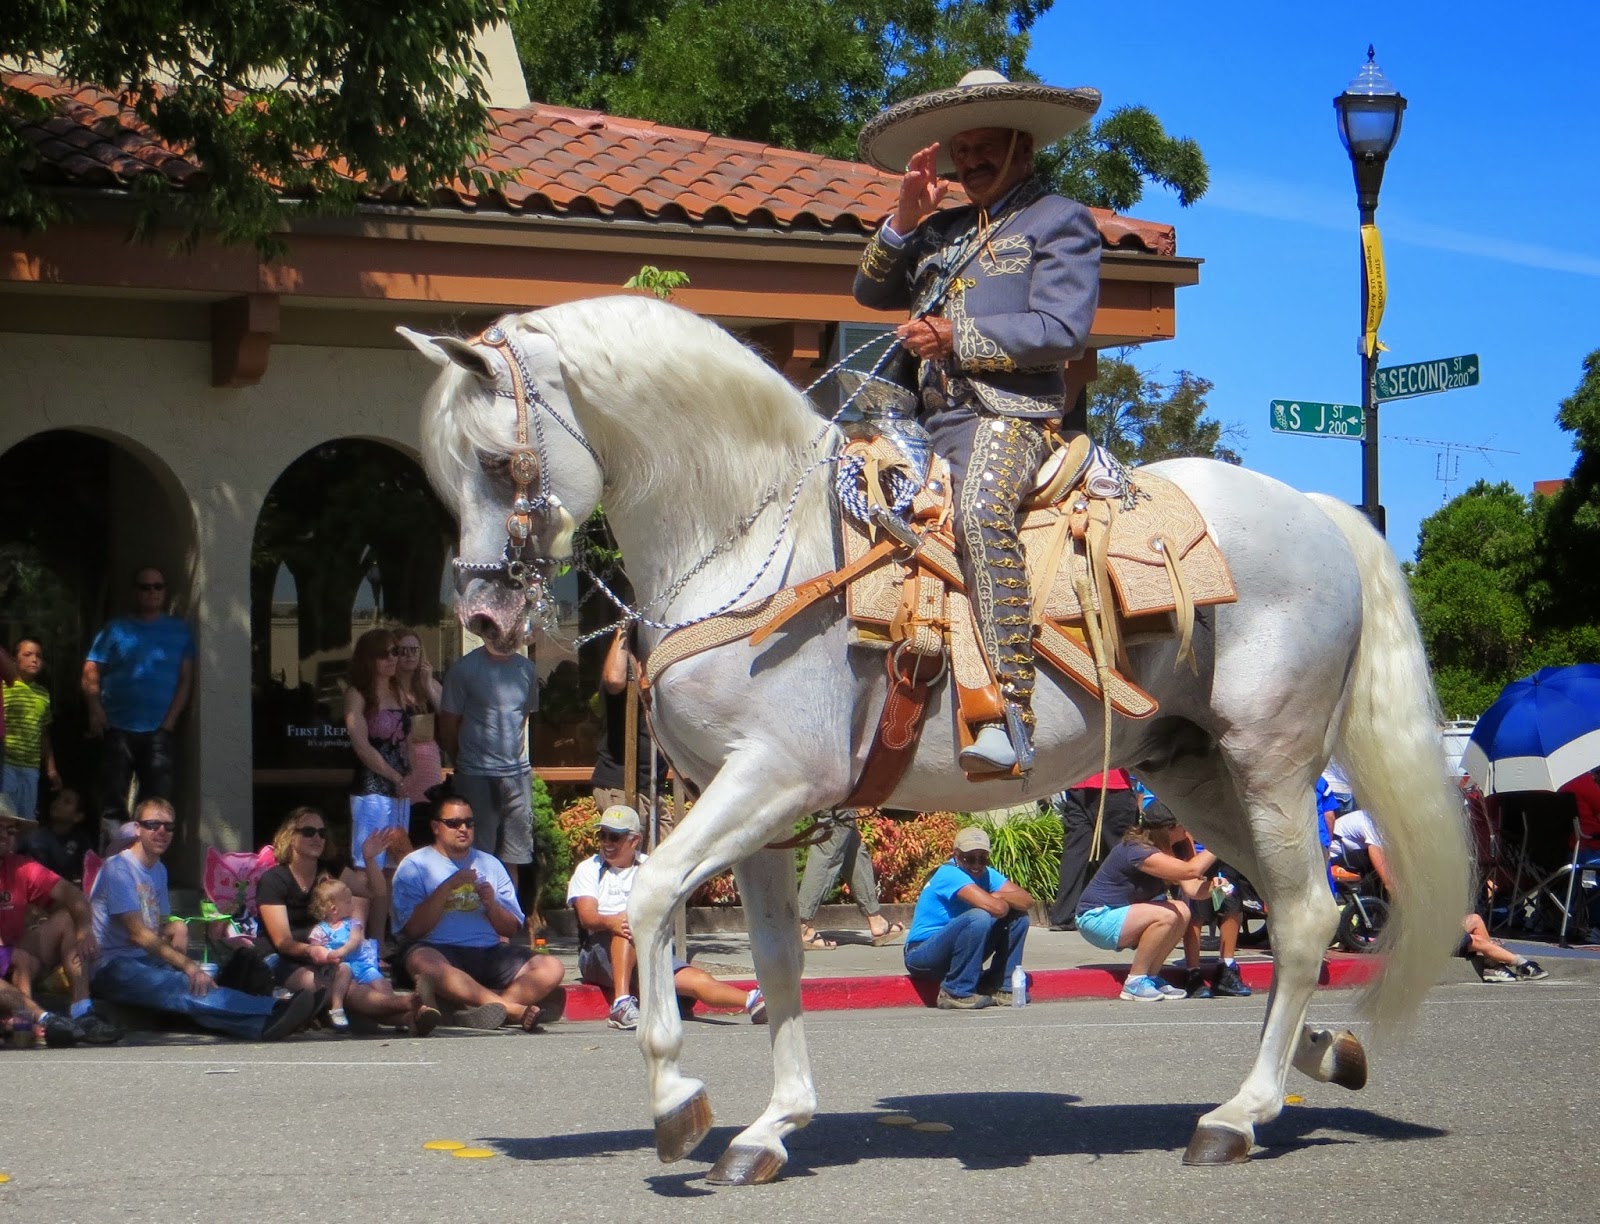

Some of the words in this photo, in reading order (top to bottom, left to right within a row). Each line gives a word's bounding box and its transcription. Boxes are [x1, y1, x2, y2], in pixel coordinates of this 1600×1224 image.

[1374, 258, 1382, 279] STEVE
[1389, 362, 1449, 395] SECOND
[1453, 356, 1463, 372] ST
[1447, 373, 1469, 389] 2200
[1289, 403, 1301, 430] S
[1314, 406, 1325, 432] J
[1332, 405, 1344, 419] ST
[1328, 421, 1348, 435] 200
[287, 724, 318, 737] FIRST
